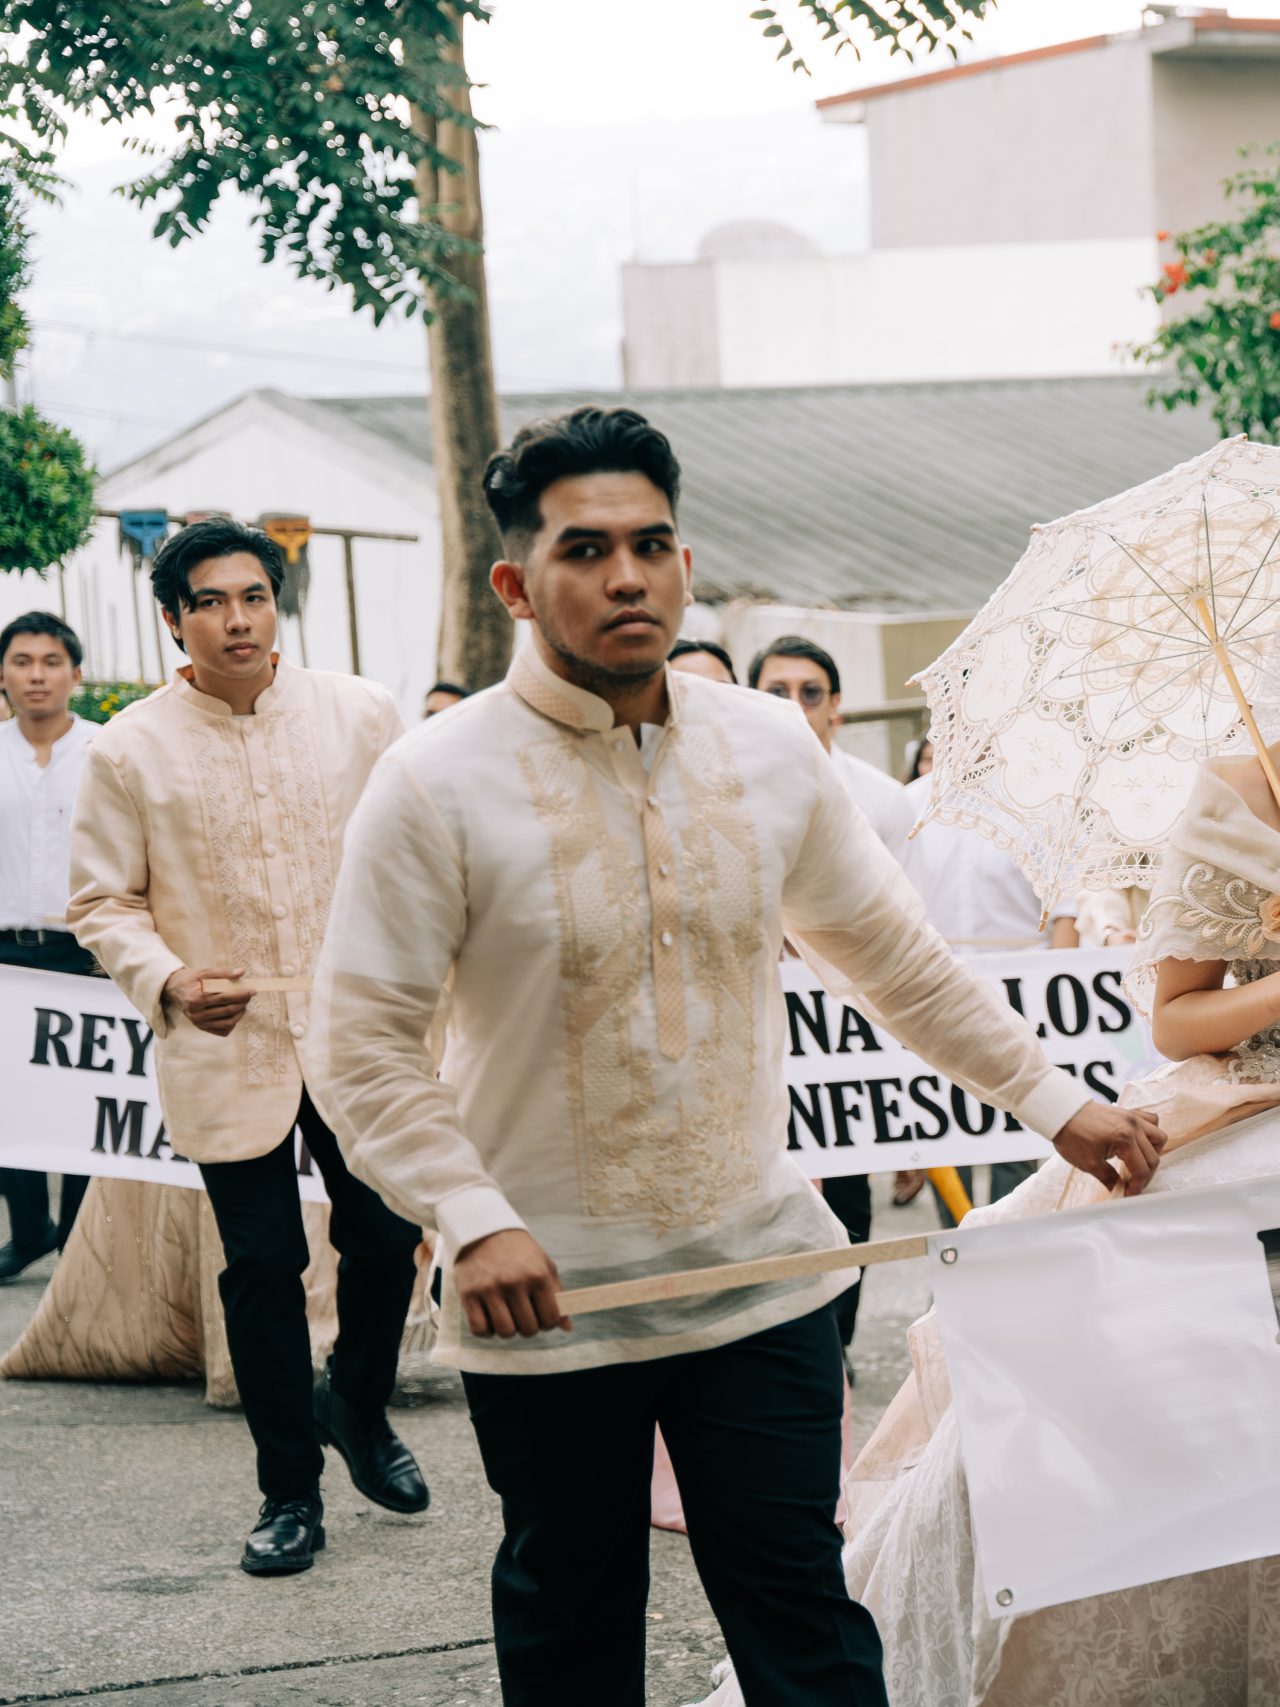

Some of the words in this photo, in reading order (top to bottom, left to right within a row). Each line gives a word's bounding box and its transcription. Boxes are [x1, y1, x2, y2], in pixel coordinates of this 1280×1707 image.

[1002, 971, 1132, 1038] LOS
[29, 1006, 154, 1077] REY
[786, 1061, 1119, 1151] NFESOS
